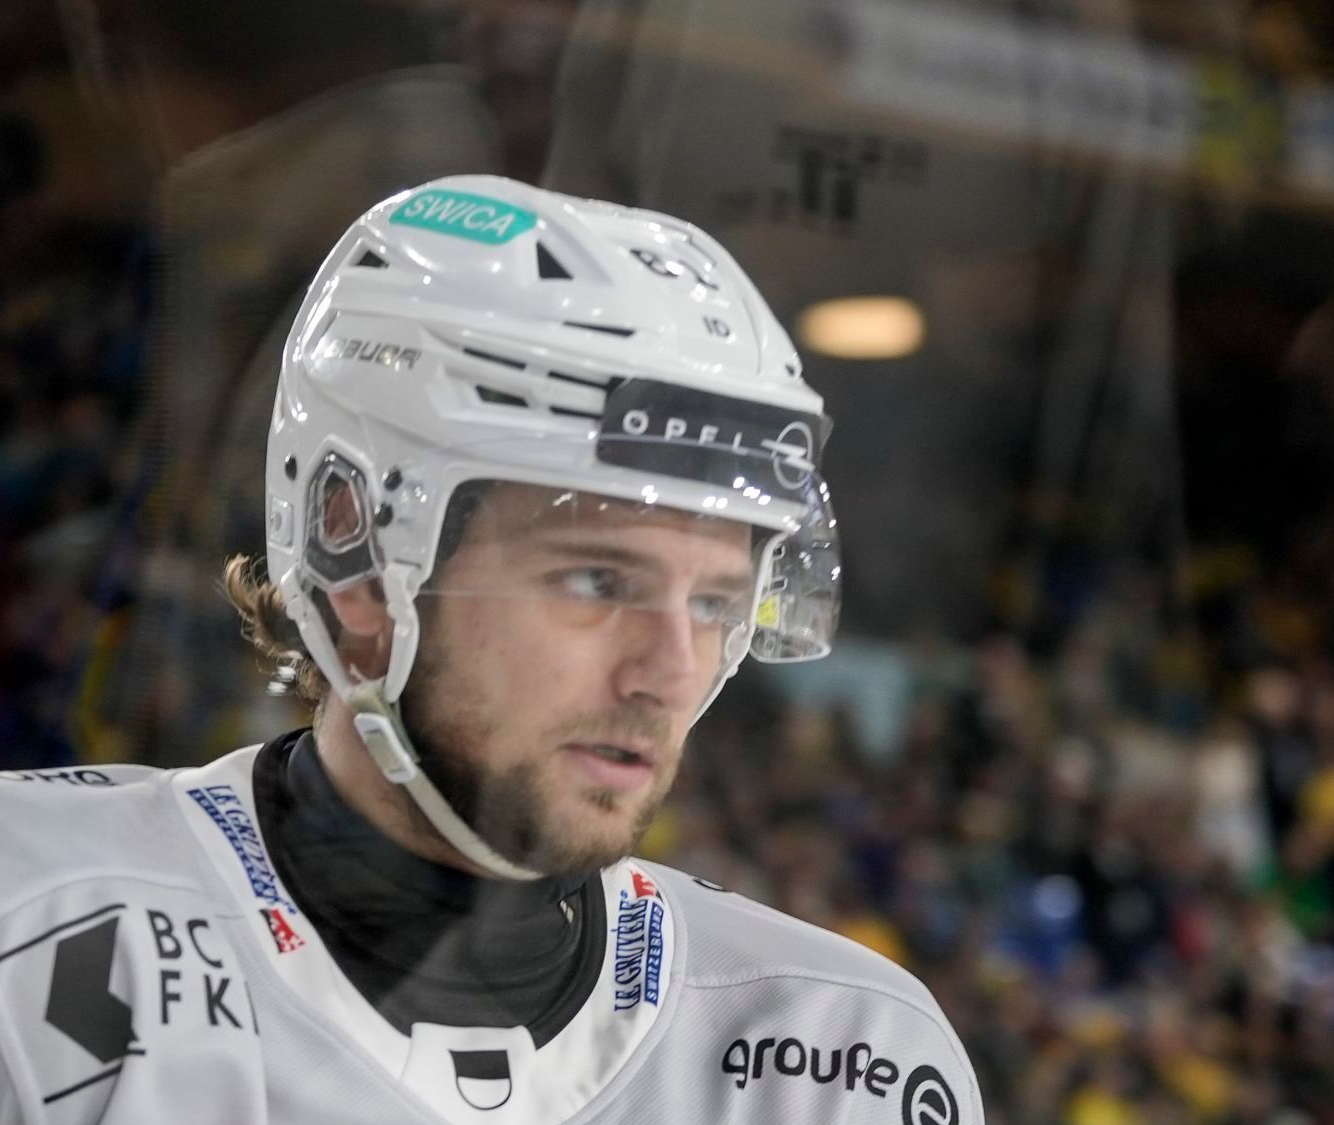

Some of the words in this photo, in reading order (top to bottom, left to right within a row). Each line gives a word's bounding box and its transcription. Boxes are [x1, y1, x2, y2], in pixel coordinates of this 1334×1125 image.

[405, 194, 516, 238] SWICA
[325, 339, 421, 370] AUER
[160, 969, 259, 1035] FK
[721, 1037, 899, 1098] groupe
